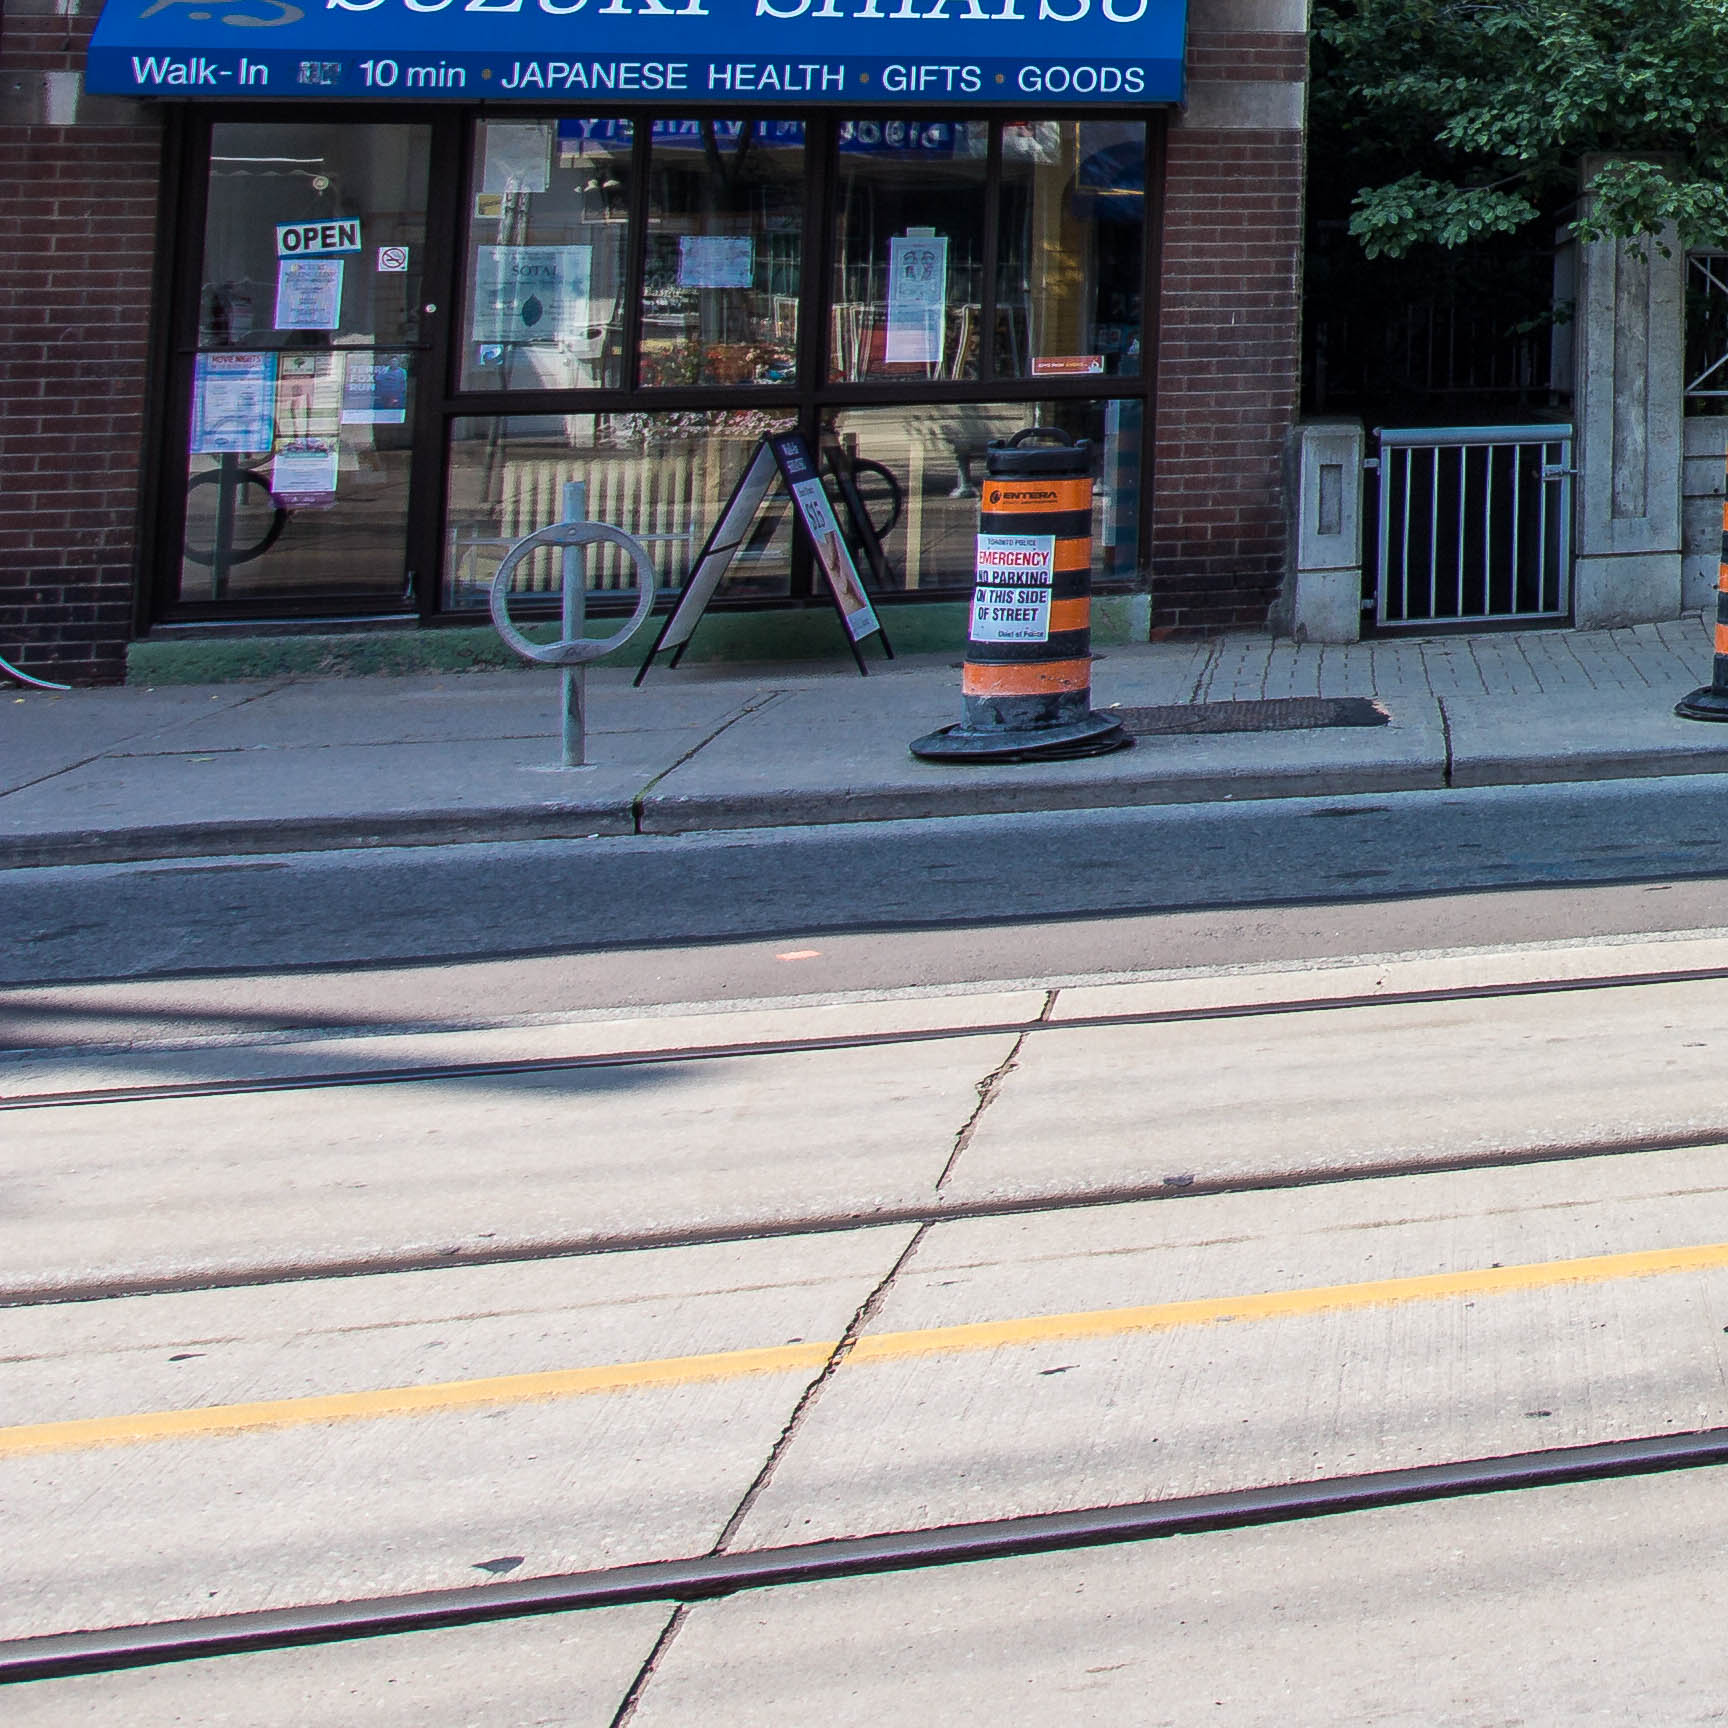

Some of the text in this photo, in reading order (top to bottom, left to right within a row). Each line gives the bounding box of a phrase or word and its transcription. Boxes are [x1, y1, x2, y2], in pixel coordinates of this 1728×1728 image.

[359, 59, 399, 87] 10
[406, 60, 466, 87] min
[501, 61, 688, 90] JAPANESE
[708, 63, 844, 91] HEALTH
[882, 64, 982, 92] GIFTS
[1018, 66, 1145, 93] GOODS
[282, 223, 357, 252] OPEN
[1003, 491, 1058, 499] ENTERA
[979, 551, 1049, 566] EMERGENCY
[978, 570, 1049, 584] NO PARKING
[976, 589, 1047, 604] ON THIS SIDE
[978, 607, 1039, 621] OF STREET
